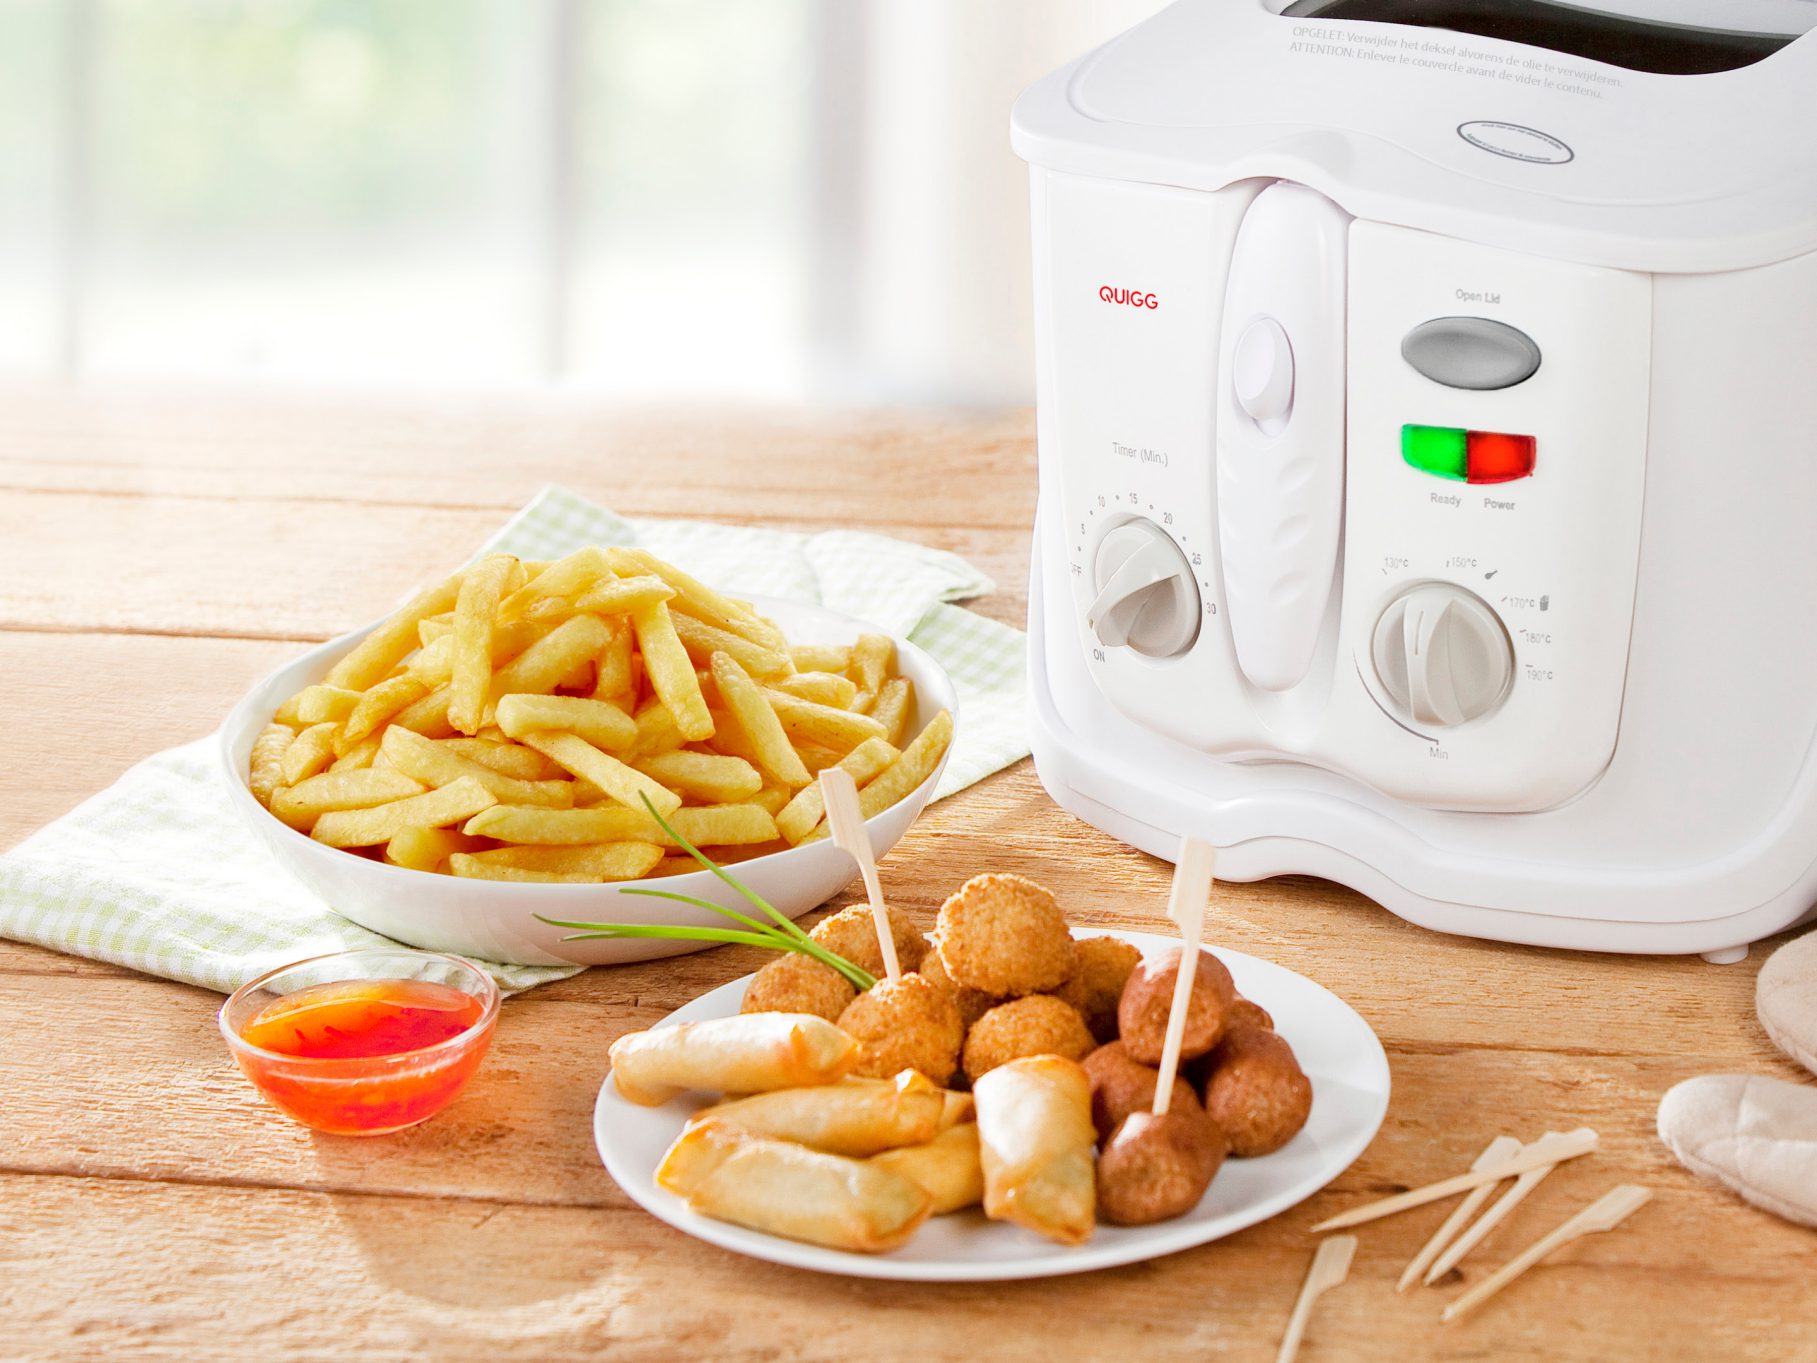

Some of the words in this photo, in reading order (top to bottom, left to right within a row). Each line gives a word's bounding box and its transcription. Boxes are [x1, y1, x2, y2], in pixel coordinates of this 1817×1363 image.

[1292, 26, 1344, 41] OPGELET:
[1347, 32, 1398, 48] Verwijder
[1401, 39, 1418, 50] het
[1421, 42, 1455, 56] deksel
[1458, 48, 1504, 64] alvorens
[1506, 55, 1520, 67] de
[1522, 58, 1542, 70] olie
[1544, 64, 1555, 73] te
[1557, 68, 1623, 88] verwijderen.
[1290, 41, 1354, 58] ATTENTION:
[1357, 49, 1396, 64] Enlever
[1400, 53, 1410, 65] le
[1412, 58, 1464, 73] couvercle
[1466, 66, 1496, 79] avant
[1498, 69, 1513, 81] de
[1515, 73, 1542, 86] vider
[1544, 78, 1553, 89] le
[1099, 285, 1159, 310] QUIGG
[1456, 288, 1482, 302] Open
[1112, 441, 1137, 458] Timer
[1140, 448, 1169, 468] (Min.)
[1097, 495, 1106, 508] 10
[1129, 492, 1138, 505] 15
[1430, 492, 1462, 508] Ready
[1484, 497, 1516, 510] Power
[1163, 511, 1173, 525] 20
[1080, 522, 1086, 535] 5
[1192, 552, 1202, 566] 25
[1206, 602, 1216, 615] 30
[1093, 648, 1106, 662] ON
[1430, 746, 1448, 760] Min
